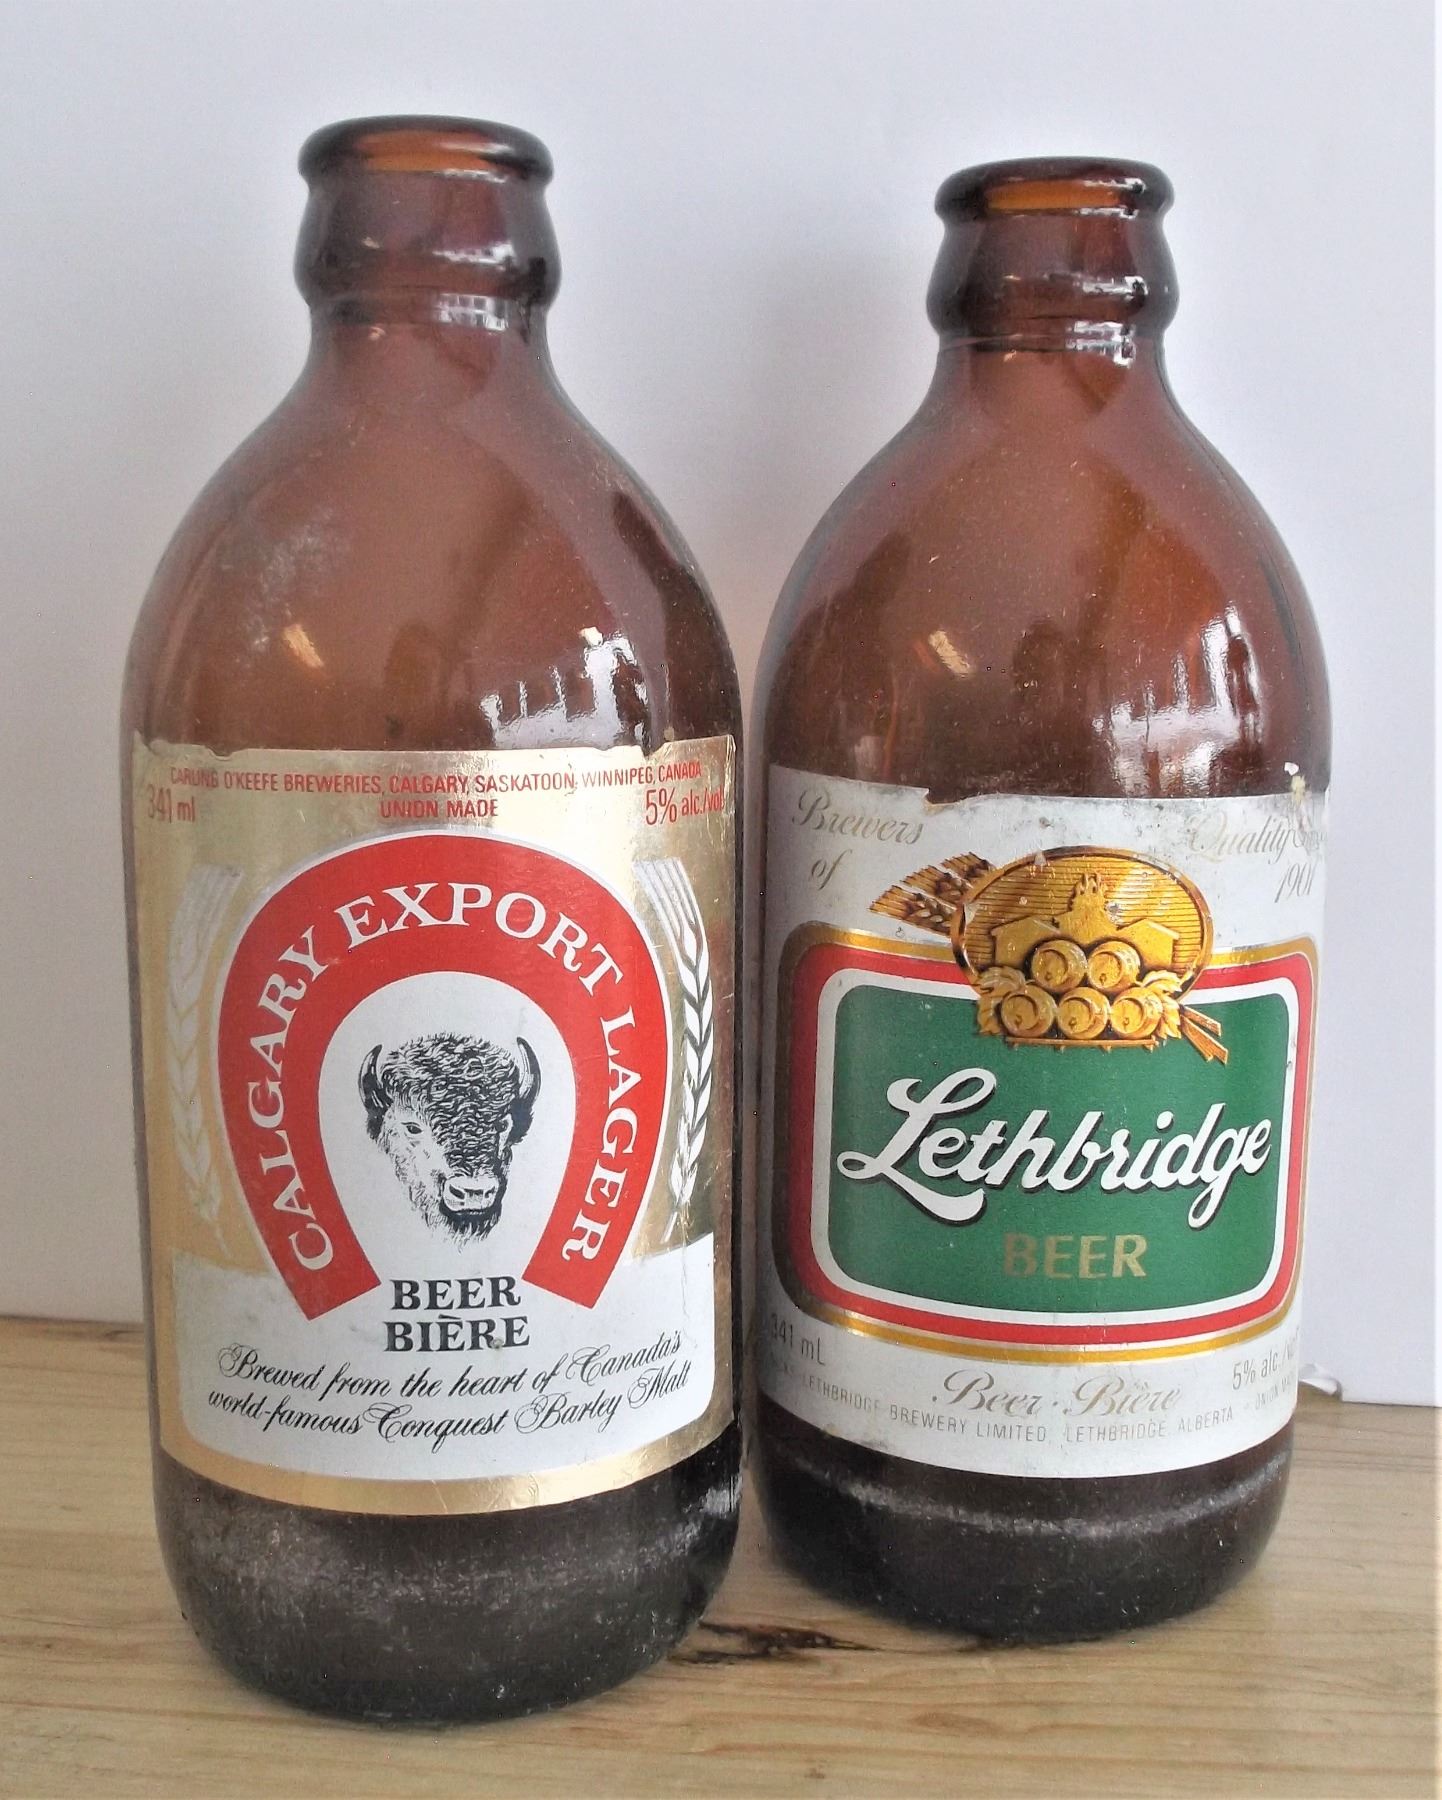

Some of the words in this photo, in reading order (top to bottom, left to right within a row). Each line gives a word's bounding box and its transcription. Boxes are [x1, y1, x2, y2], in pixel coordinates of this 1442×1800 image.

[170, 767, 218, 788] CARLING
[224, 771, 278, 791] O'KEEFE
[284, 774, 384, 796] BREWERIES,
[658, 761, 702, 783] CANADA
[148, 783, 173, 824] 341
[177, 797, 196, 823] ml
[380, 800, 438, 819] UNION
[449, 799, 499, 818] MADE
[645, 788, 678, 825] 5%
[791, 789, 924, 845] Brewers
[1188, 811, 1294, 864] Quality
[811, 849, 853, 890] of
[247, 925, 334, 1271] CALGARY
[333, 881, 624, 997] EXPORT
[561, 1004, 644, 1262] LAGER
[836, 1067, 1272, 1230] Lethbridge
[1003, 1233, 1148, 1280] BEER
[389, 1275, 521, 1311] BEER
[383, 1313, 530, 1352] BIÈRE
[770, 1313, 794, 1351] 341
[801, 1338, 826, 1366] mL
[218, 1343, 324, 1391] Brewed
[318, 1362, 392, 1402] from
[400, 1366, 443, 1398] the
[447, 1365, 528, 1398] heart
[532, 1353, 569, 1394] of
[566, 1330, 682, 1386] Canada's
[1232, 1361, 1256, 1391] 5%
[208, 1390, 363, 1435] world-famous
[363, 1402, 510, 1455] Conquest
[513, 1390, 623, 1434] Barley
[627, 1360, 692, 1410] Malt
[943, 1369, 1045, 1419] Beer
[889, 1405, 967, 1435] BREWERY
[1177, 1405, 1234, 1434] ALBERTA
